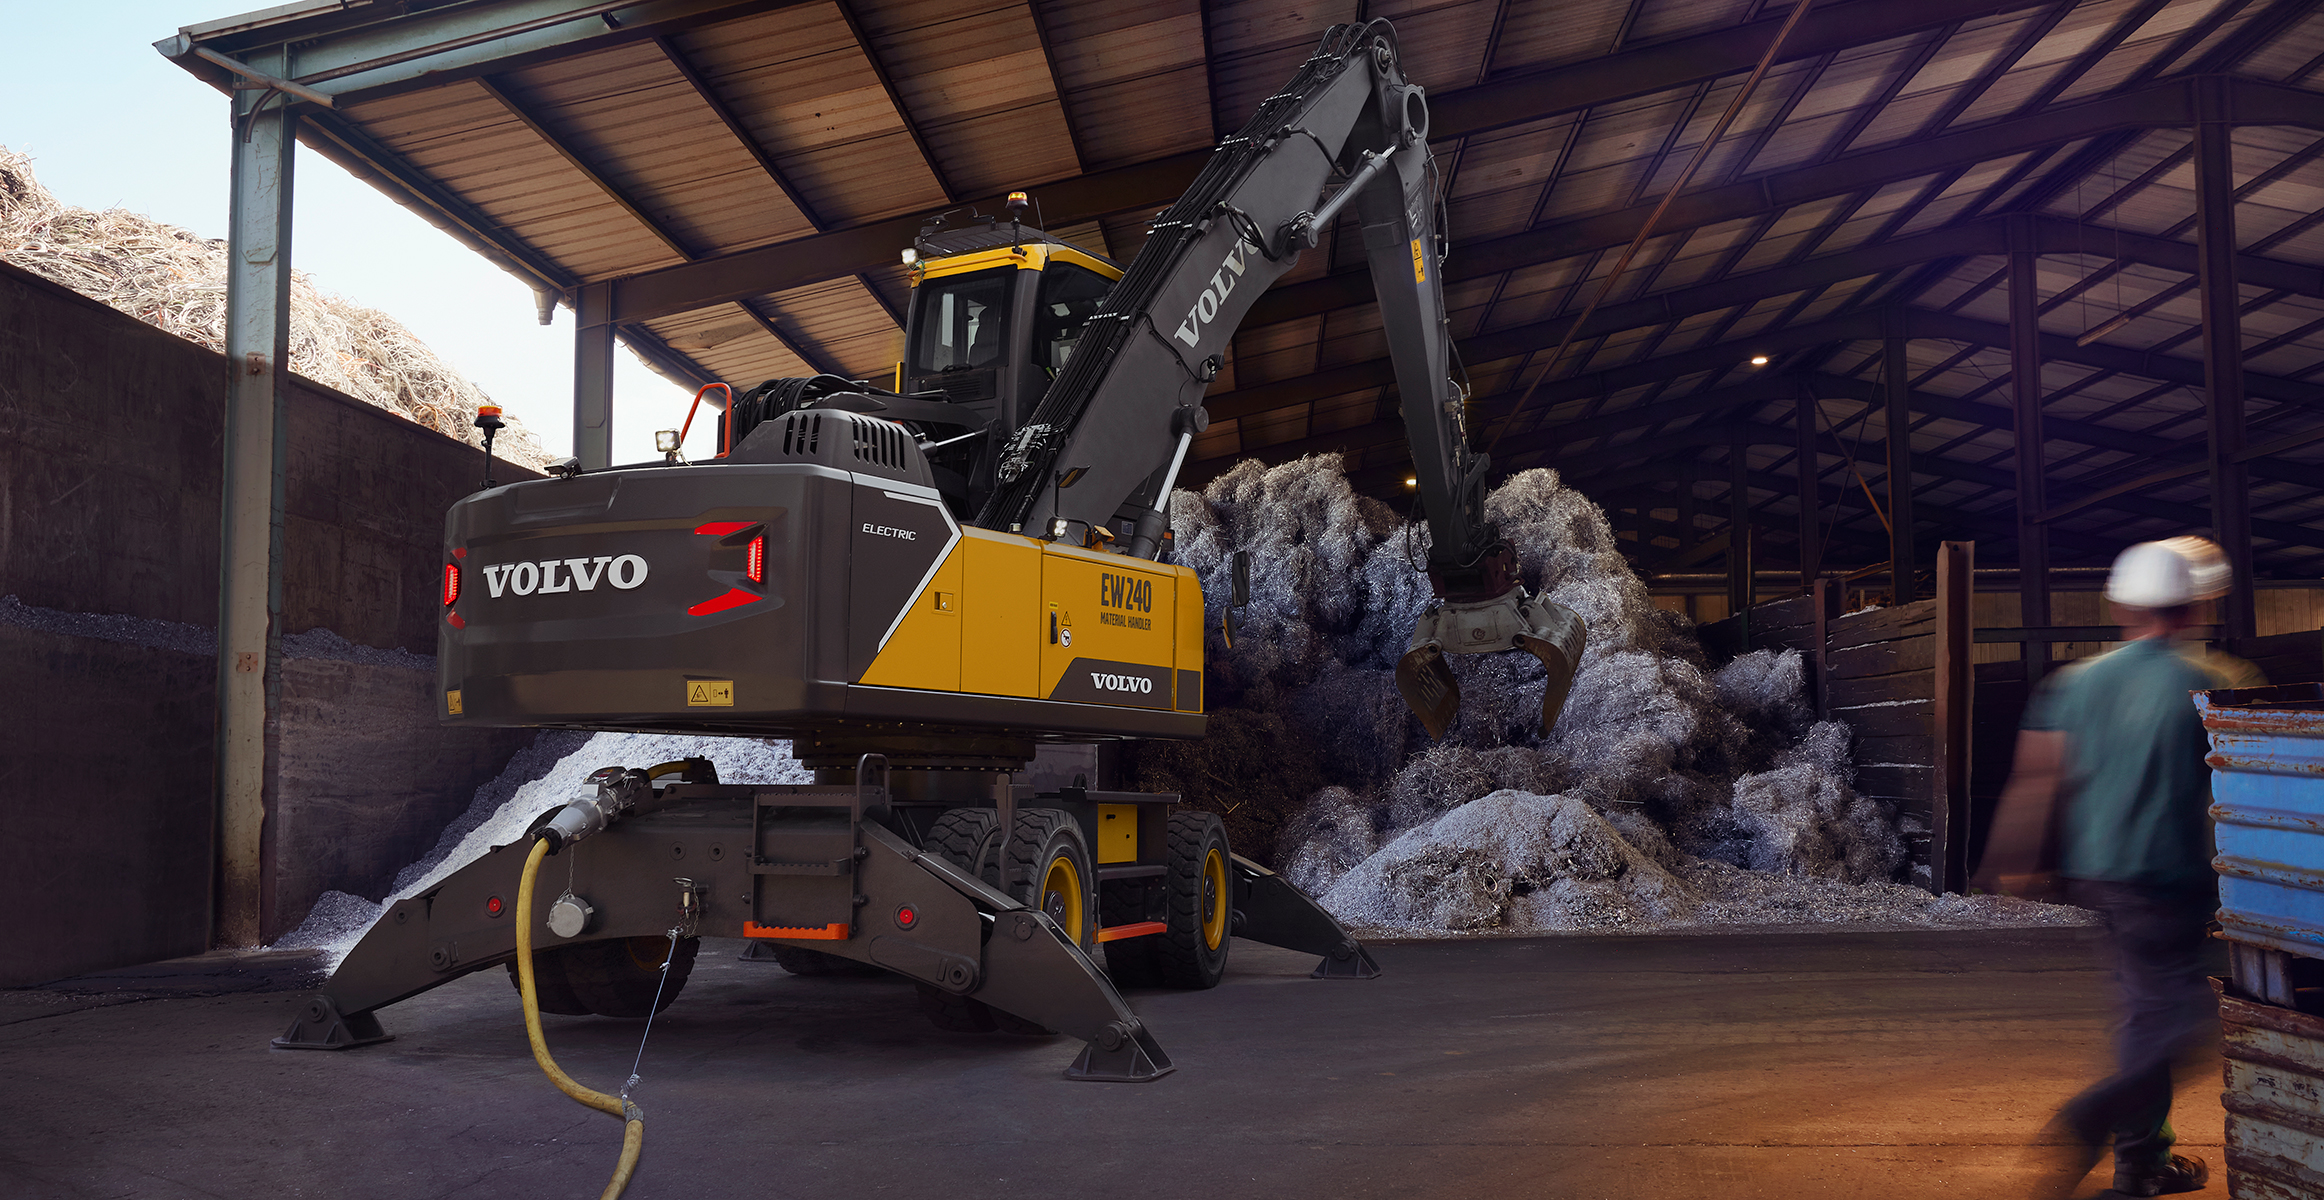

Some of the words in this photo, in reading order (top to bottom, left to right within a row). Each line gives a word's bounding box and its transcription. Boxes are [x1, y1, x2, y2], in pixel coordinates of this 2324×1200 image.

[862, 523, 917, 541] ELECTRIC
[482, 553, 649, 599] VOLVO
[1101, 572, 1152, 613] EW240
[1100, 611, 1127, 628] MATERIAL
[1127, 615, 1152, 631] HANDLER
[1090, 672, 1153, 694] VOLVO
